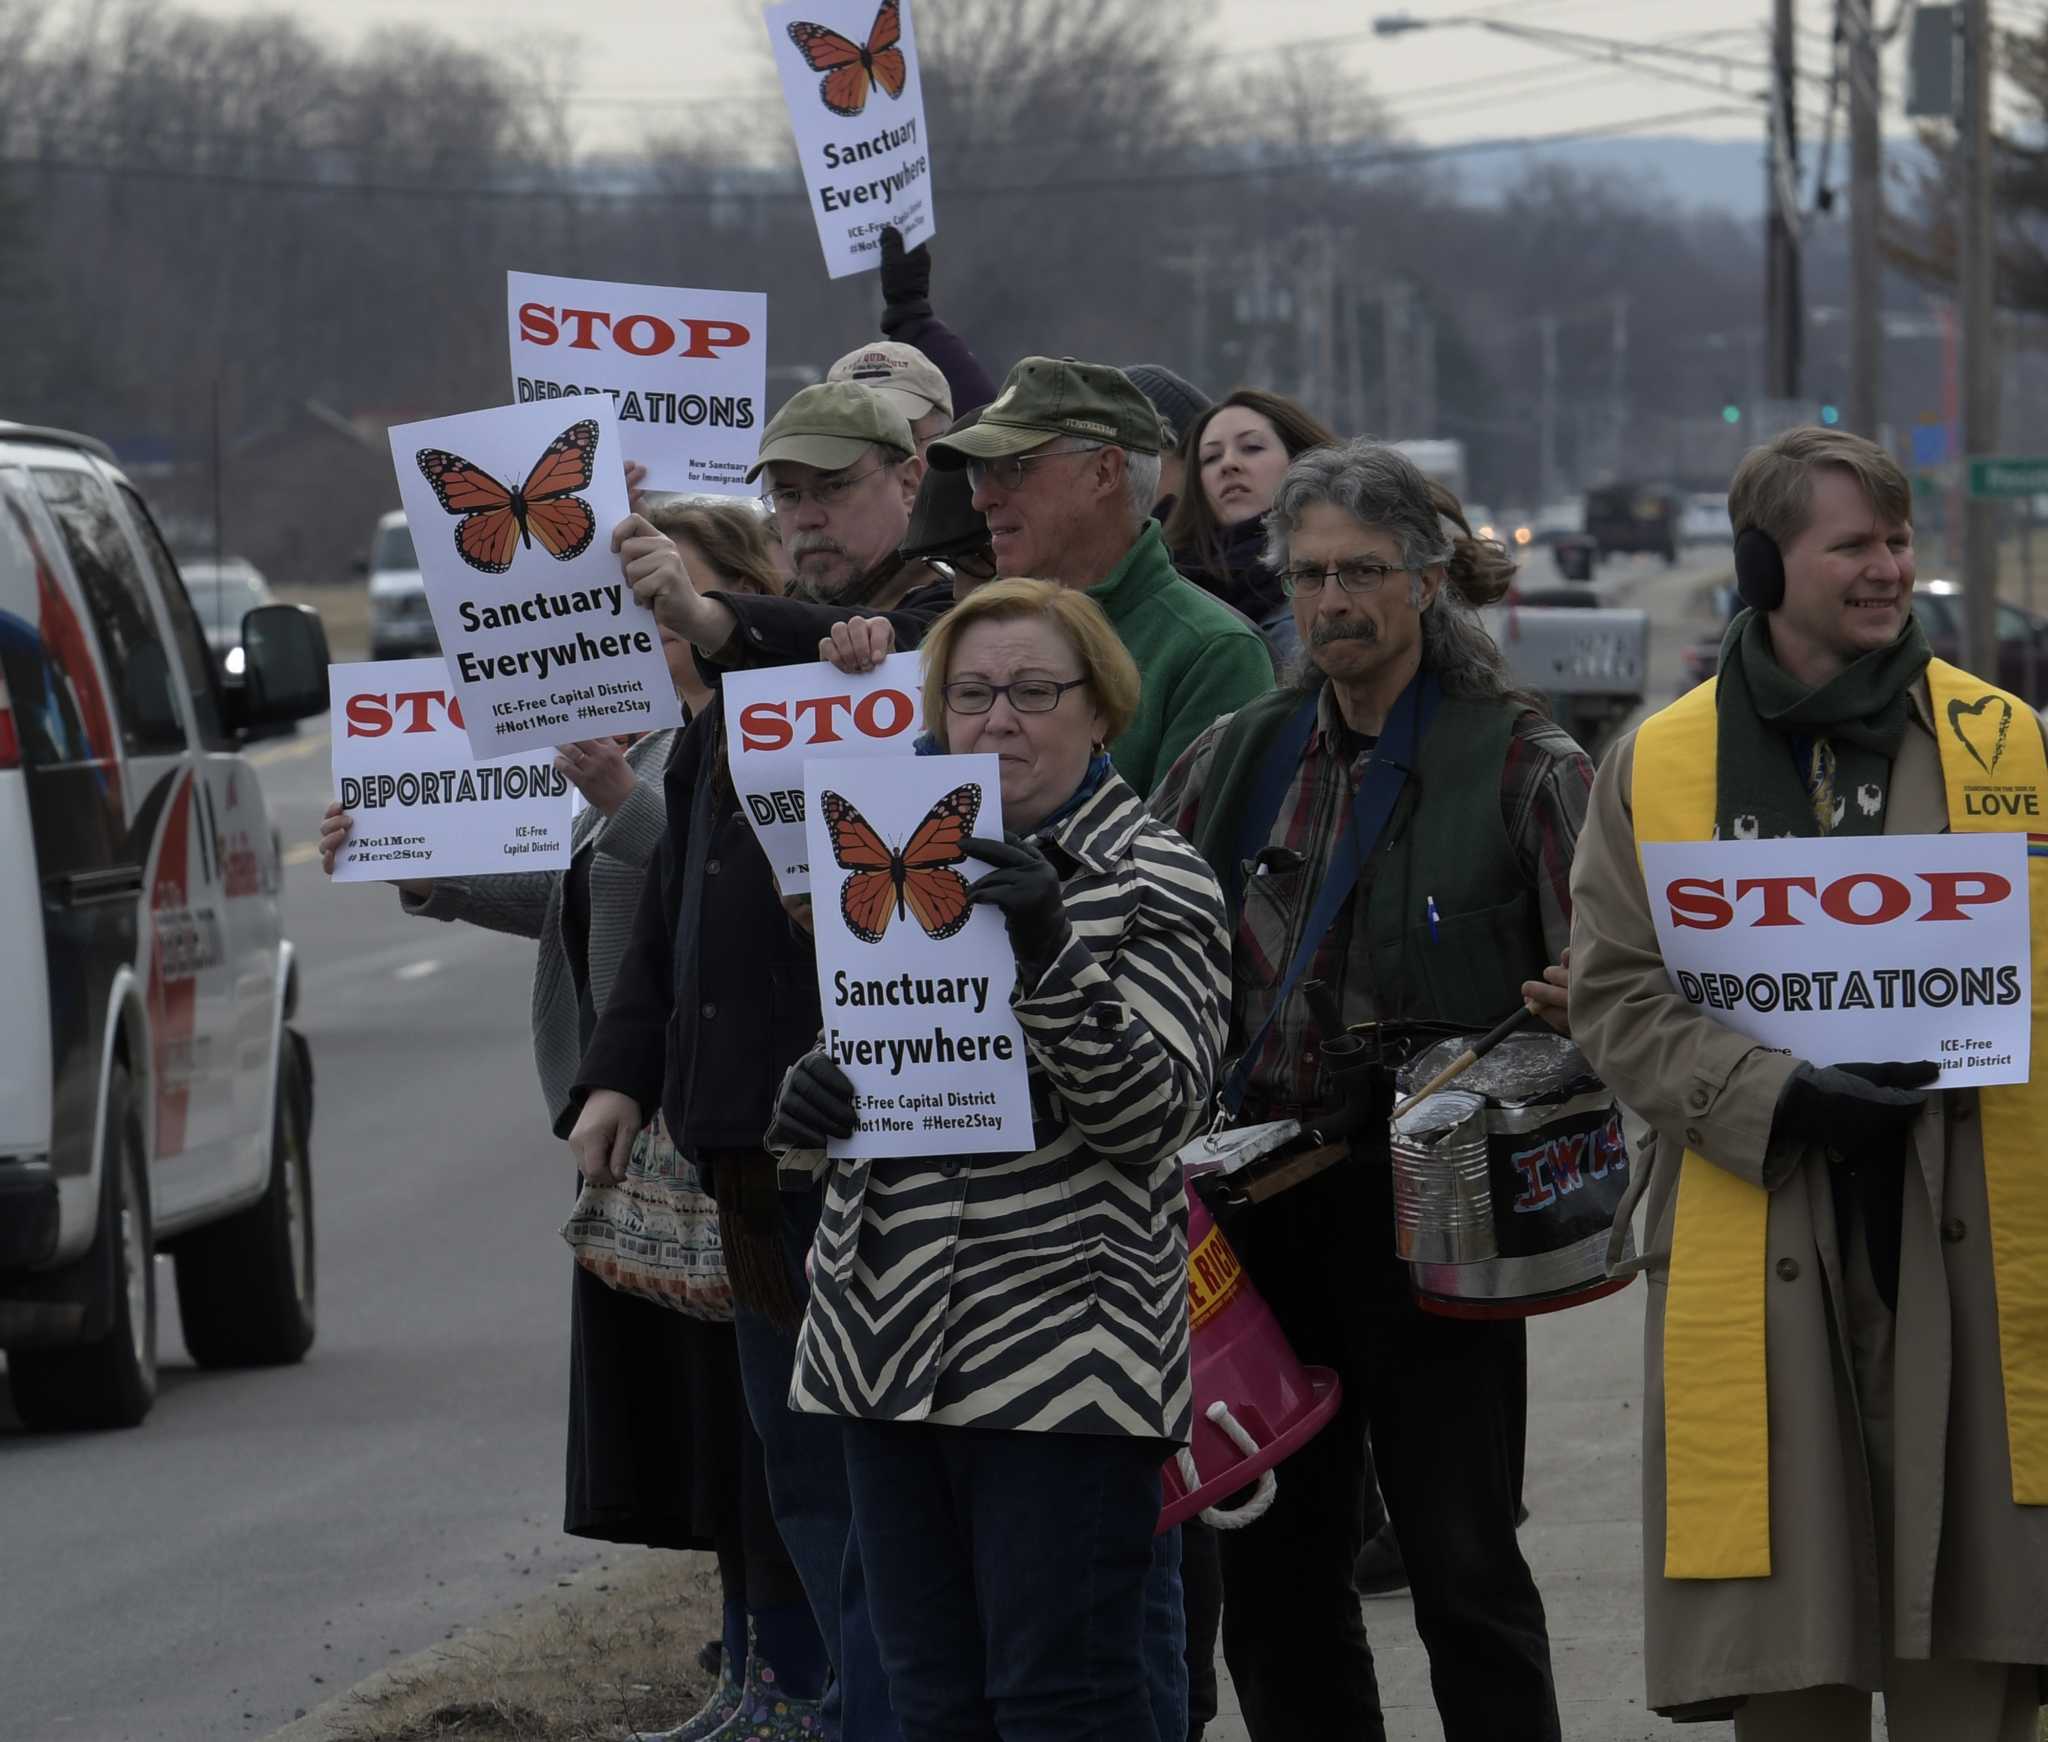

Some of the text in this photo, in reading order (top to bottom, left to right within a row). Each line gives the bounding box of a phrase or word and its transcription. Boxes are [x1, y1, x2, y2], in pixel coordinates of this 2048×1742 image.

[824, 117, 917, 169] Sanctuary
[819, 156, 926, 212] Everywhere
[519, 302, 750, 359] STOP
[517, 377, 755, 429] DEPATIONS
[689, 459, 748, 473] New Sanctuary
[702, 473, 744, 485] Immigrant
[459, 584, 621, 632] Sanctuary
[457, 631, 652, 683] Everywhere
[346, 691, 465, 738] ST
[493, 680, 643, 717] ICE-Free Capital District
[496, 700, 651, 735] #Not1More #Here2Stay
[739, 686, 927, 753] STO
[341, 764, 567, 810] DEPORTATIONS
[1965, 793, 2040, 816] LOVE
[349, 835, 425, 848] #Not1More
[504, 842, 559, 856] Capital District
[515, 826, 548, 838] ICE-Free
[348, 850, 432, 863] #Here2Stay
[1666, 872, 2012, 930] STOP
[834, 970, 989, 1013] Sanctuary
[1677, 966, 2021, 1012] DEPORTATIONS
[831, 1027, 1012, 1076] Everywhere
[1941, 1039, 1992, 1052] ICE-Free
[1968, 1054, 2012, 1068] District
[899, 1093, 943, 1112] Capital
[948, 1091, 996, 1106] District
[853, 1113, 1002, 1132] Not1More #Here2Stay
